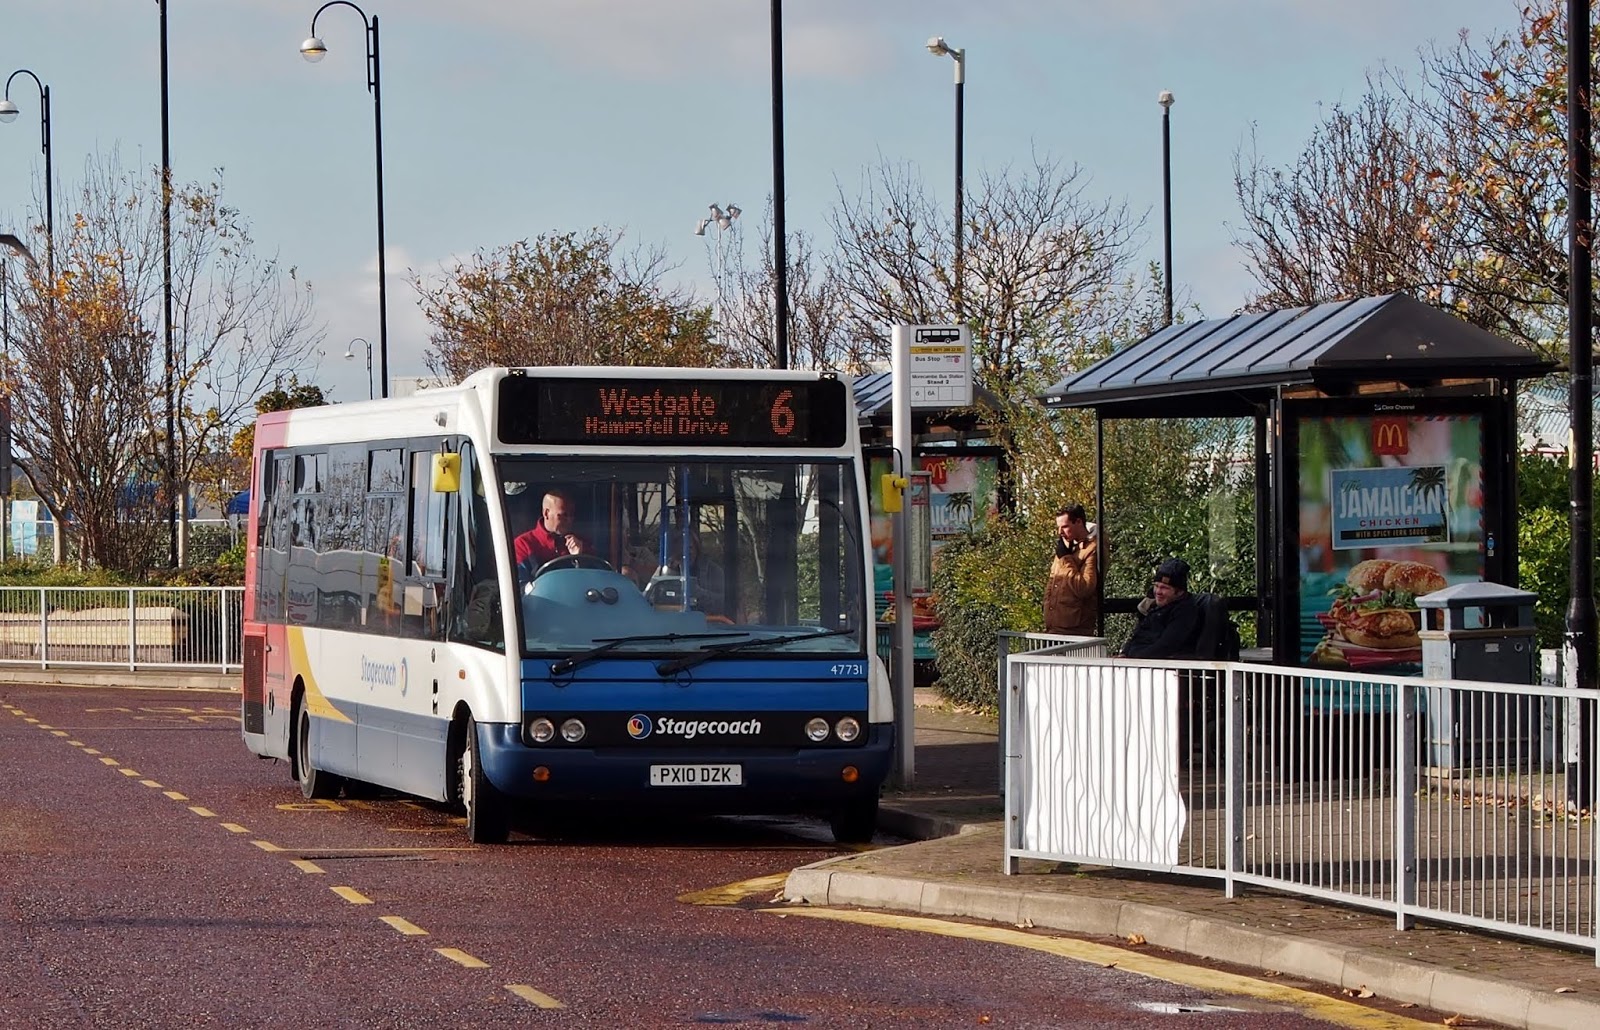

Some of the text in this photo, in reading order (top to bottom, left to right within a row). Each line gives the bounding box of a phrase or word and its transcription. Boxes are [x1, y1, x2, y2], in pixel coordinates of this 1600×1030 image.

[599, 388, 716, 416] Westgate
[770, 389, 796, 436] 6
[678, 417, 729, 434] Drive
[1340, 484, 1441, 519] JAMAICAN
[1359, 517, 1420, 528] CHICKEN
[1372, 530, 1392, 538] SPICY
[1409, 528, 1428, 536] SAUCE
[361, 654, 397, 691] Stagecoach
[830, 664, 863, 675] 47731
[655, 717, 762, 739] Stagecoach
[660, 767, 732, 782] PX10 DZK
